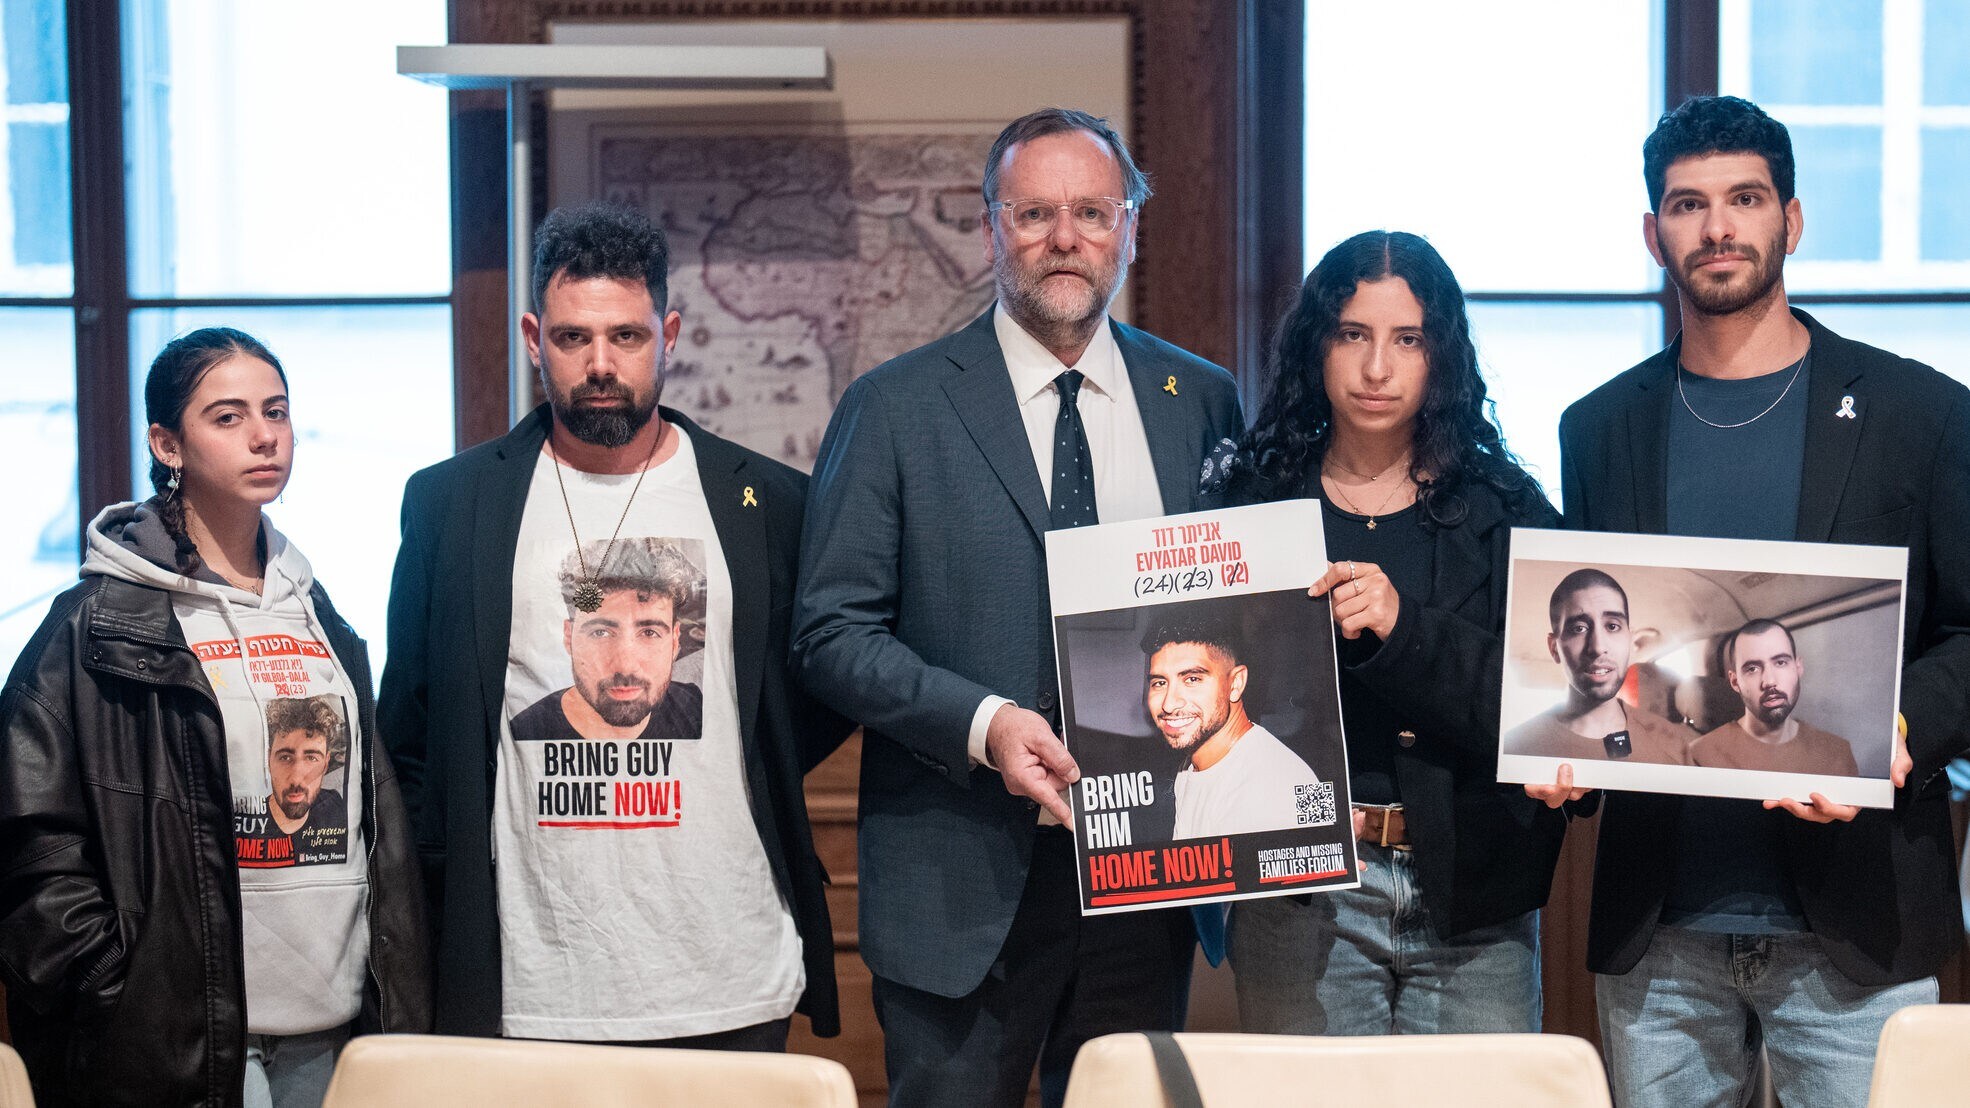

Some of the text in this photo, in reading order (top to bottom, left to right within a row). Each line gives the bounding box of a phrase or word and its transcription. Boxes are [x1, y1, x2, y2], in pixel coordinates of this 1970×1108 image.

[1152, 521, 1222, 548] אביתר דוד
[1136, 541, 1242, 573] EVYATAR DAVID
[249, 637, 293, 657] חטוף
[261, 671, 311, 683] GILBOA-DALAL
[544, 742, 673, 777] BRING GUY
[538, 780, 682, 820] HOME NOW!
[1081, 770, 1155, 812] BRING
[1085, 811, 1133, 850] HIM
[236, 834, 295, 859] OME NOW!
[1257, 842, 1343, 862] HOSTAGES AND MISSING
[1089, 837, 1233, 891] HOME NOW!
[1259, 854, 1345, 879] FAMILIES FORUM
